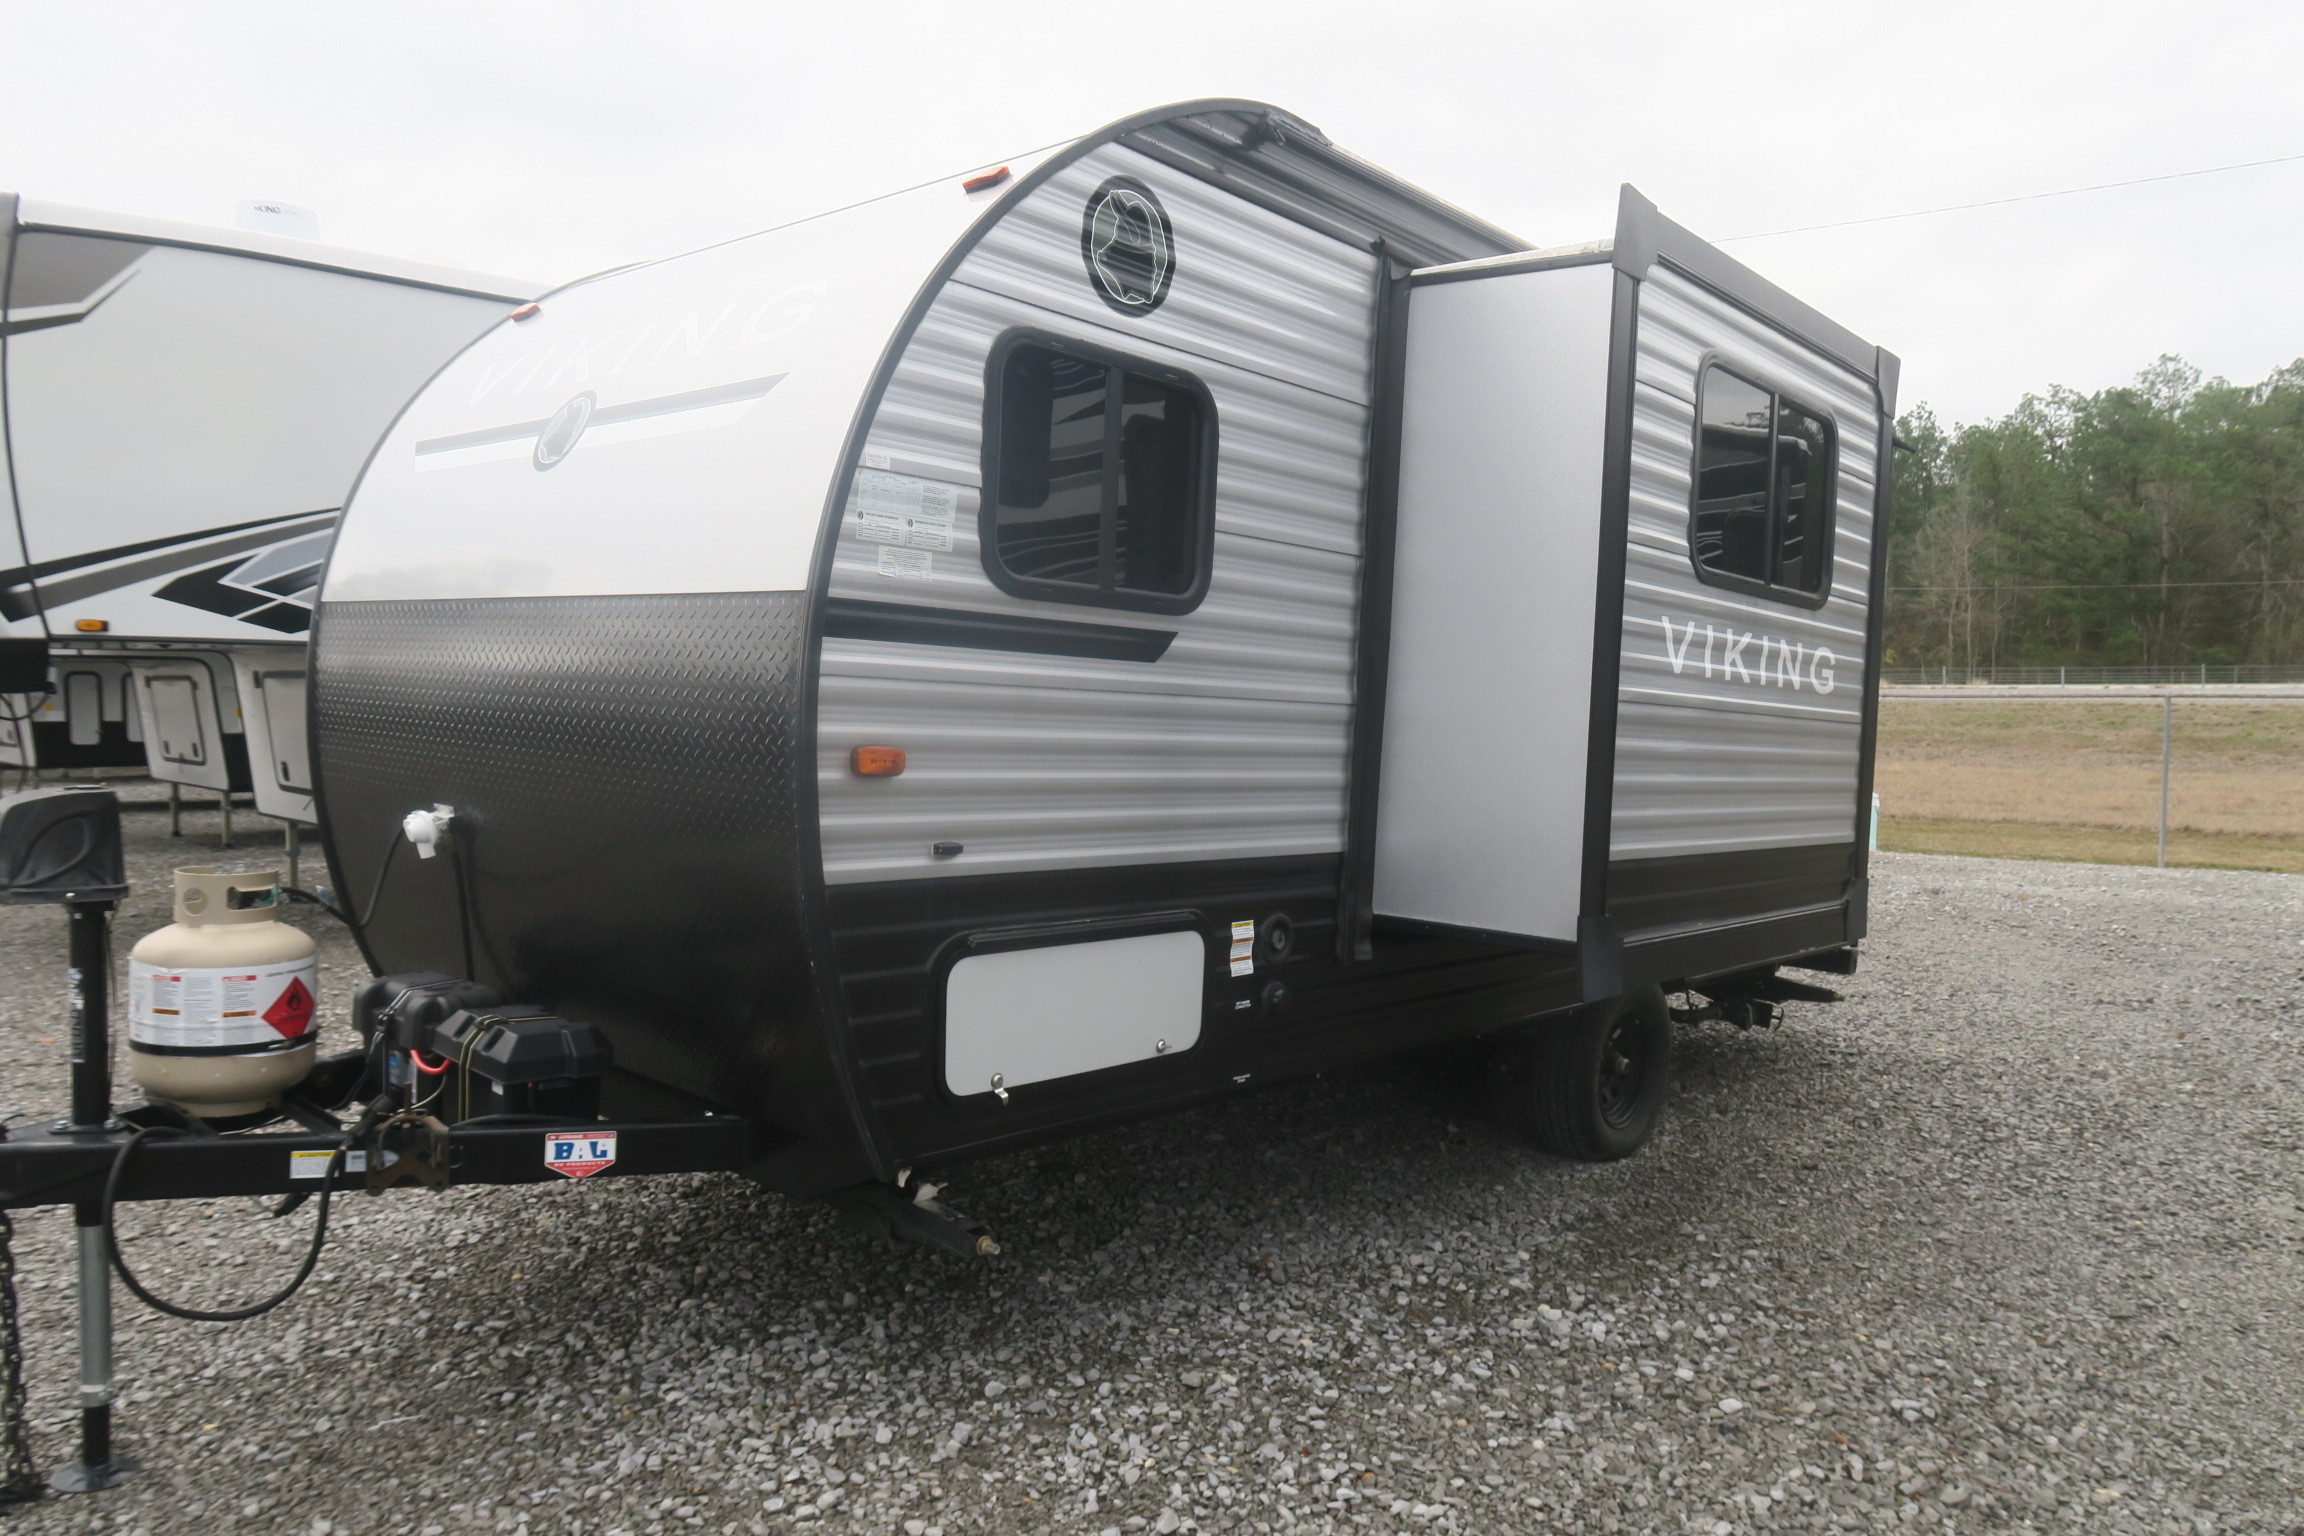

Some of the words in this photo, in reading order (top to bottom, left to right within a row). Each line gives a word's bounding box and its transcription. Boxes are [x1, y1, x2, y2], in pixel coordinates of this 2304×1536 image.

[469, 279, 829, 406] VIKING
[1661, 616, 1836, 694] VIKING
[554, 1141, 608, 1160] BAL
